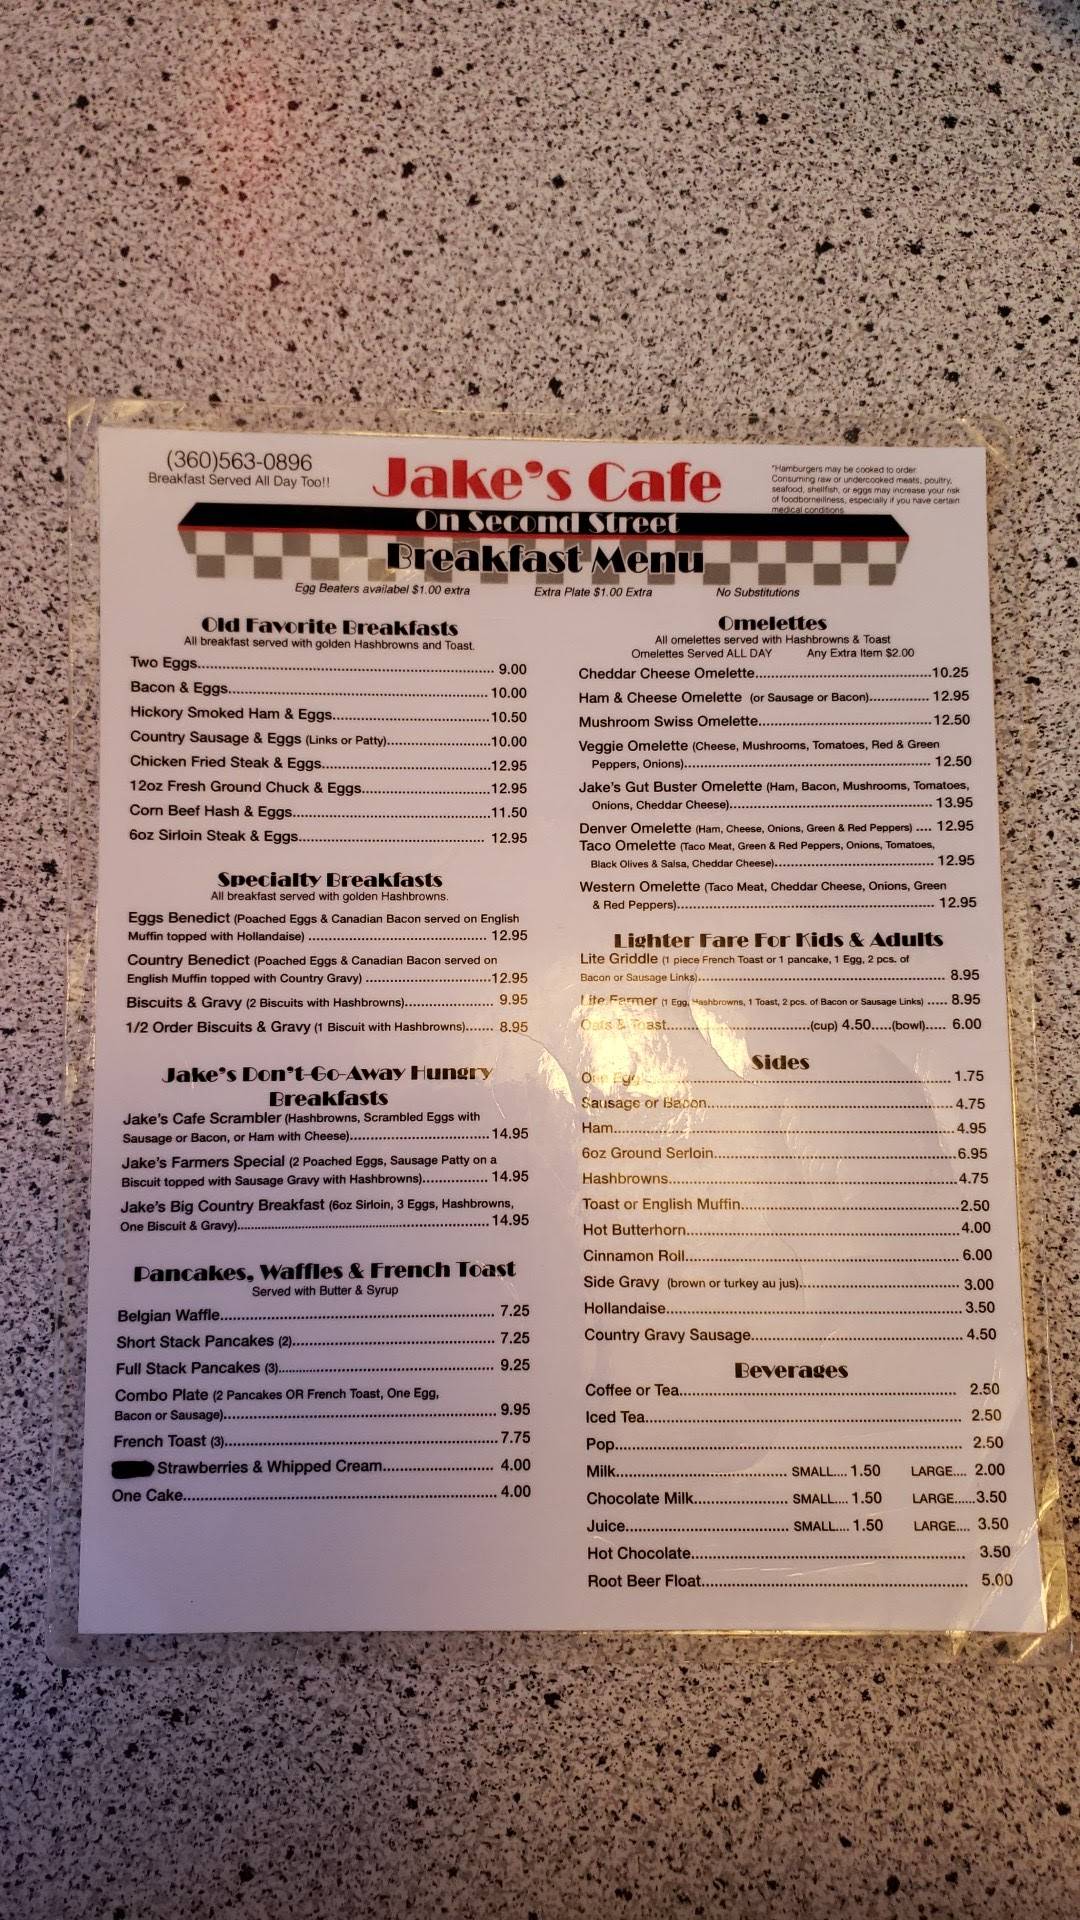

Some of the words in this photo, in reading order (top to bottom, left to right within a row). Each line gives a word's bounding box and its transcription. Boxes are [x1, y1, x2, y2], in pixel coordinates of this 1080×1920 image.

[167, 450, 312, 472] (360)563-0896
[148, 472, 205, 484] Breakfast
[209, 474, 252, 485] Served
[256, 475, 269, 485] All
[273, 476, 297, 488] Day
[301, 476, 330, 488] Too!!
[372, 457, 572, 502] Jake's
[588, 462, 722, 502] Cafe
[416, 509, 460, 532] On
[468, 511, 581, 533] Second
[589, 513, 681, 534] Street
[387, 542, 583, 574] Breakfast
[591, 545, 705, 574] Menu
[295, 583, 316, 595] Egg
[319, 583, 359, 593] Beaters
[363, 585, 409, 595] availabel
[412, 585, 441, 595] $1.00
[444, 586, 471, 595] extra
[534, 587, 561, 597] Extra
[564, 587, 591, 597] Plate
[593, 587, 623, 598] $1.00
[626, 588, 653, 597] Extra
[716, 588, 731, 597] No
[734, 588, 800, 598] Substitutions
[202, 617, 240, 633] Old
[246, 618, 337, 635] Favorite
[343, 620, 459, 637] Breakfasts
[718, 616, 828, 631] Omelettes
[184, 636, 197, 645] All
[201, 637, 249, 647] breakfast
[253, 638, 288, 647] served
[292, 639, 312, 648] with
[316, 640, 351, 651] golden
[354, 640, 419, 650] Hashbrowns
[423, 641, 442, 650] and
[445, 641, 475, 651] Toast.
[807, 648, 827, 660] Any
[830, 648, 857, 657] Extra
[861, 648, 882, 657] Item
[885, 648, 915, 658] $2.00
[130, 655, 159, 669] Two
[498, 663, 527, 676] 9.00
[579, 668, 636, 679] Cheddar
[640, 668, 690, 679] Cheese
[579, 693, 609, 703] Ham
[613, 692, 623, 703] &
[627, 692, 677, 703] Cheese
[682, 692, 742, 703] Omelette
[932, 689, 970, 702] 12.95
[131, 706, 183, 721] Hickory
[188, 706, 243, 719] Smoked
[249, 708, 280, 719] Ham
[131, 730, 185, 745] Country
[190, 731, 250, 746] Sausage
[254, 732, 262, 743] &
[267, 733, 302, 747] Eggs
[305, 735, 337, 746] (Links
[579, 741, 623, 755] Veggie
[628, 740, 688, 751] Omelette
[693, 742, 738, 753] (Cheese,
[743, 741, 809, 752] Mushrooms,
[812, 741, 868, 752] Tomatoes,
[580, 823, 627, 834] Denver
[631, 822, 691, 833] Omelette
[807, 824, 835, 832] Green
[838, 824, 845, 832] &
[848, 824, 867, 832] Red
[870, 823, 913, 834] Peppers)
[129, 829, 154, 840] 6oz
[159, 829, 202, 841] Sirloin
[207, 830, 246, 841] Steak
[491, 832, 528, 844] 12.95
[218, 872, 321, 888] Specialty
[327, 872, 443, 888] Breakfasts
[128, 912, 164, 926] Eggs
[169, 912, 230, 924] Benedict
[234, 913, 286, 925] (Poached
[290, 914, 317, 925] Eggs
[321, 914, 328, 923] &
[332, 914, 382, 923] Canadian
[387, 914, 420, 923] Bacon
[614, 933, 695, 949] Lighter
[700, 934, 749, 948] Fare
[755, 933, 790, 948] For
[796, 932, 844, 948] Kids
[849, 932, 864, 948] &
[870, 932, 944, 948] Adults
[580, 953, 605, 964] Lite
[609, 953, 658, 965] Griddle
[674, 956, 699, 966] piece
[703, 956, 734, 964] French
[788, 955, 831, 965] pancake,
[950, 968, 980, 981] 8.95
[126, 1021, 148, 1033] 1/2
[153, 1021, 194, 1033] Order
[198, 1021, 252, 1033] Biscuits
[257, 1021, 266, 1032] &
[271, 1021, 311, 1036] Gravy
[499, 1021, 529, 1033] 8.95
[952, 1017, 982, 1030] 6.00
[752, 1054, 810, 1070] Sides
[162, 1067, 237, 1083] Jake's
[243, 1066, 405, 1083] Don't-Go-Away
[411, 1065, 493, 1081] Hungry
[954, 1069, 985, 1082] 1.75
[269, 1090, 388, 1107] Breakfasts
[491, 1127, 529, 1140] 14.95
[121, 1201, 166, 1214] Jake's
[170, 1200, 194, 1215] Big
[198, 1200, 254, 1215] Country
[258, 1199, 325, 1212] Breakfast
[356, 1200, 394, 1211] Sirloin,
[442, 1199, 514, 1210] Hashbrowns,
[583, 1250, 654, 1262] Cinnamon
[962, 1248, 993, 1262] 6.00
[134, 1264, 254, 1283] Pancakes,
[260, 1263, 343, 1280] Waffles
[348, 1263, 364, 1279] &
[371, 1262, 450, 1279] French
[456, 1261, 517, 1278] Toast
[583, 1276, 614, 1288] Side
[619, 1276, 659, 1291] Gravy
[667, 1278, 706, 1289] (brown
[723, 1278, 759, 1291] turkey
[252, 1286, 291, 1297] Served
[294, 1286, 316, 1296] with
[319, 1285, 352, 1296] Butter
[355, 1285, 363, 1295] &
[366, 1285, 399, 1298] Syrup
[117, 1308, 172, 1326] Belgian
[500, 1304, 530, 1317] 7.25
[734, 1363, 849, 1379] Beverages
[115, 1389, 168, 1402] Combo
[173, 1388, 208, 1401] Plate
[227, 1390, 283, 1401] Pancakes
[286, 1389, 304, 1400] OR
[307, 1389, 347, 1400] French
[350, 1388, 383, 1401] Toast,
[585, 1383, 632, 1397] Coffee
[969, 1382, 1000, 1396] 2.50
[500, 1402, 531, 1416] 9.95
[157, 1461, 248, 1474] Strawberries
[253, 1461, 262, 1473] &
[267, 1460, 332, 1476] Whipped
[500, 1458, 532, 1472] 4.00
[974, 1462, 1006, 1476] 2.00
[111, 1488, 142, 1503] One
[500, 1484, 532, 1498] 4.00
[587, 1492, 659, 1505] Chocolate
[851, 1490, 883, 1505] 1.50
[588, 1574, 622, 1587] Root
[627, 1574, 662, 1587] Beer
[981, 1572, 1014, 1587] 5.00
